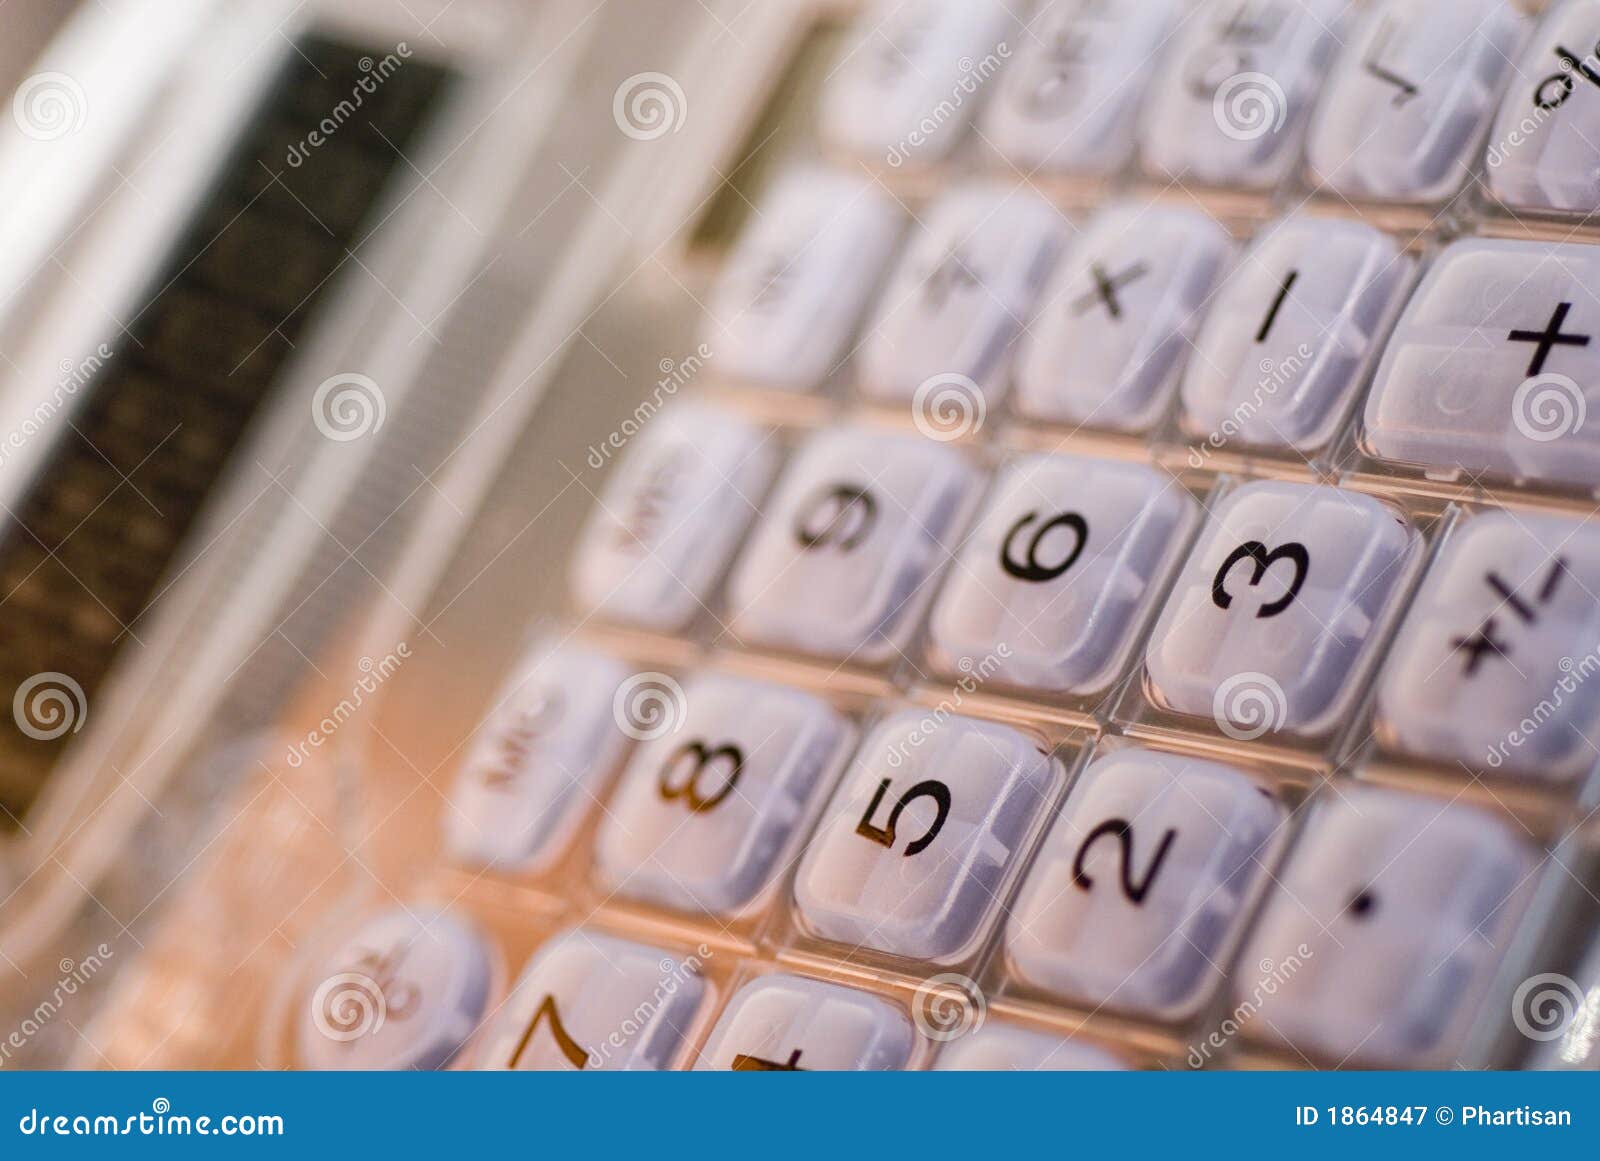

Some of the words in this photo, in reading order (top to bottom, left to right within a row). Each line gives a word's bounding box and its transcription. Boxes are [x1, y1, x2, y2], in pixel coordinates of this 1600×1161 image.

[793, 480, 879, 554] 9
[1000, 510, 1089, 583] 6
[1212, 541, 1309, 618] 3
[659, 740, 744, 814] 8
[856, 777, 952, 857] 5
[1071, 817, 1178, 907] 2
[507, 993, 590, 1070] 7
